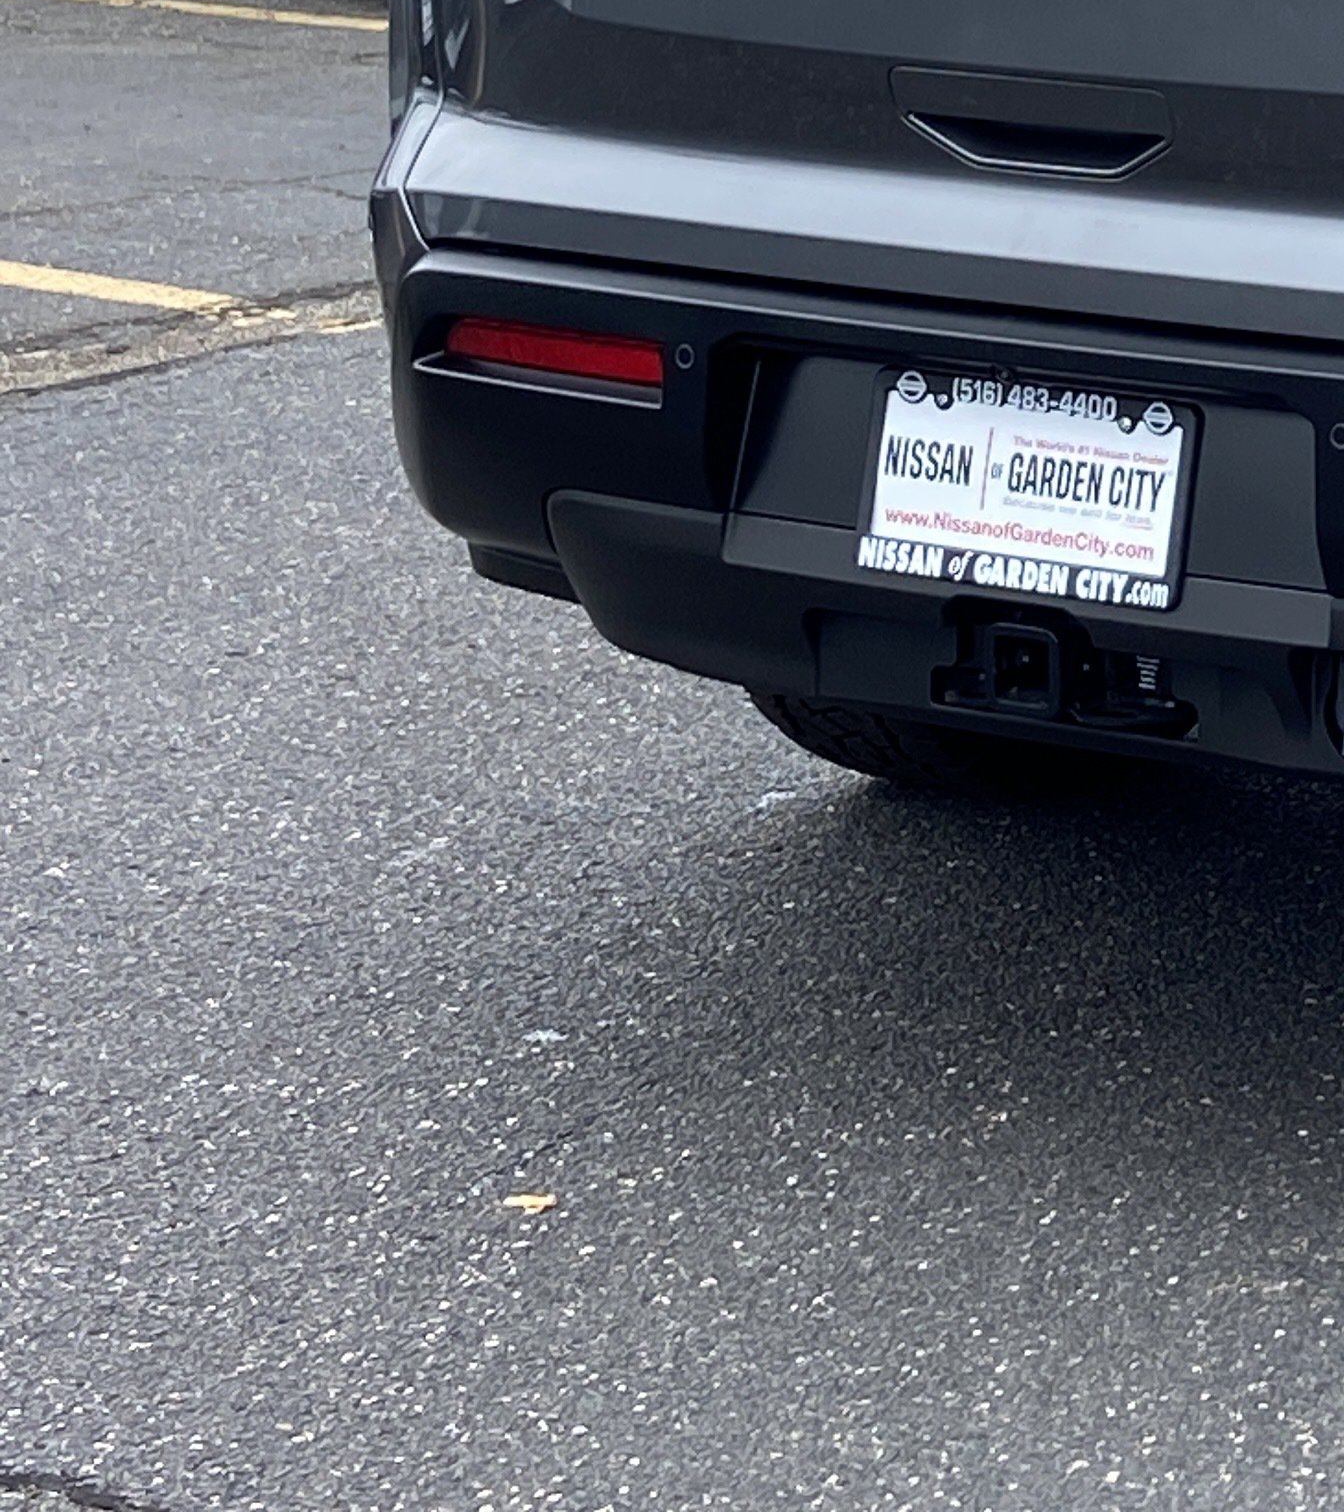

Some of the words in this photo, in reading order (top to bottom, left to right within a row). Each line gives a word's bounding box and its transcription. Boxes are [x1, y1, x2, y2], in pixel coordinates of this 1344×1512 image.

[952, 377, 1002, 407] (516)
[1007, 384, 1118, 422] 483-4400
[884, 434, 974, 487] NISSAN
[1007, 452, 1104, 505] GARDEN
[1108, 466, 1166, 513] CITY
[885, 508, 1154, 562] www.NissanofGardenCity.com
[858, 535, 944, 578] NISSAN
[947, 549, 975, 581] of
[973, 553, 1070, 597] GARDEN
[1075, 567, 1169, 609] CITY.com
